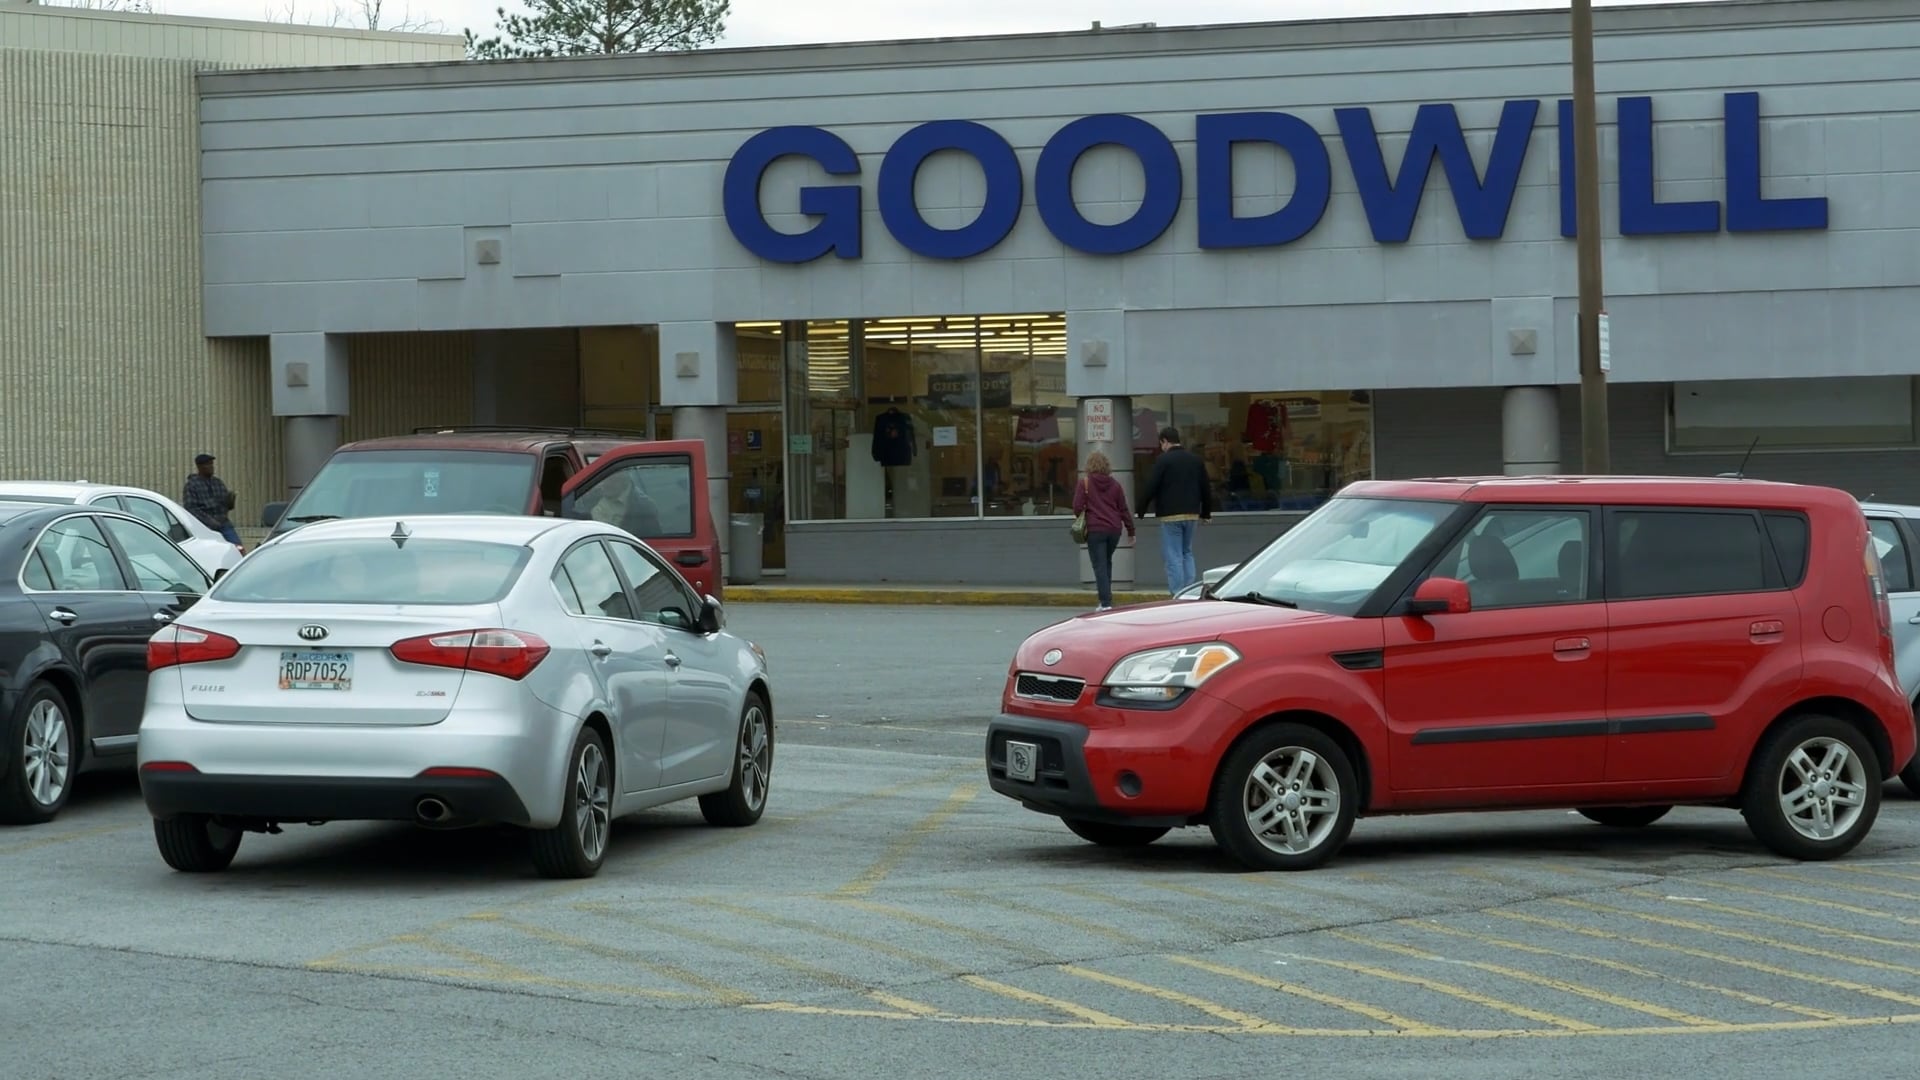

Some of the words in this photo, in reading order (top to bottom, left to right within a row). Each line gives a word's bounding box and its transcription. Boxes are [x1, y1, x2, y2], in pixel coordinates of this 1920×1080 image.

[1093, 404, 1105, 413] NO
[1087, 415, 1112, 424] PARKING
[302, 627, 323, 638] KIA
[285, 661, 348, 681] RDP7052
